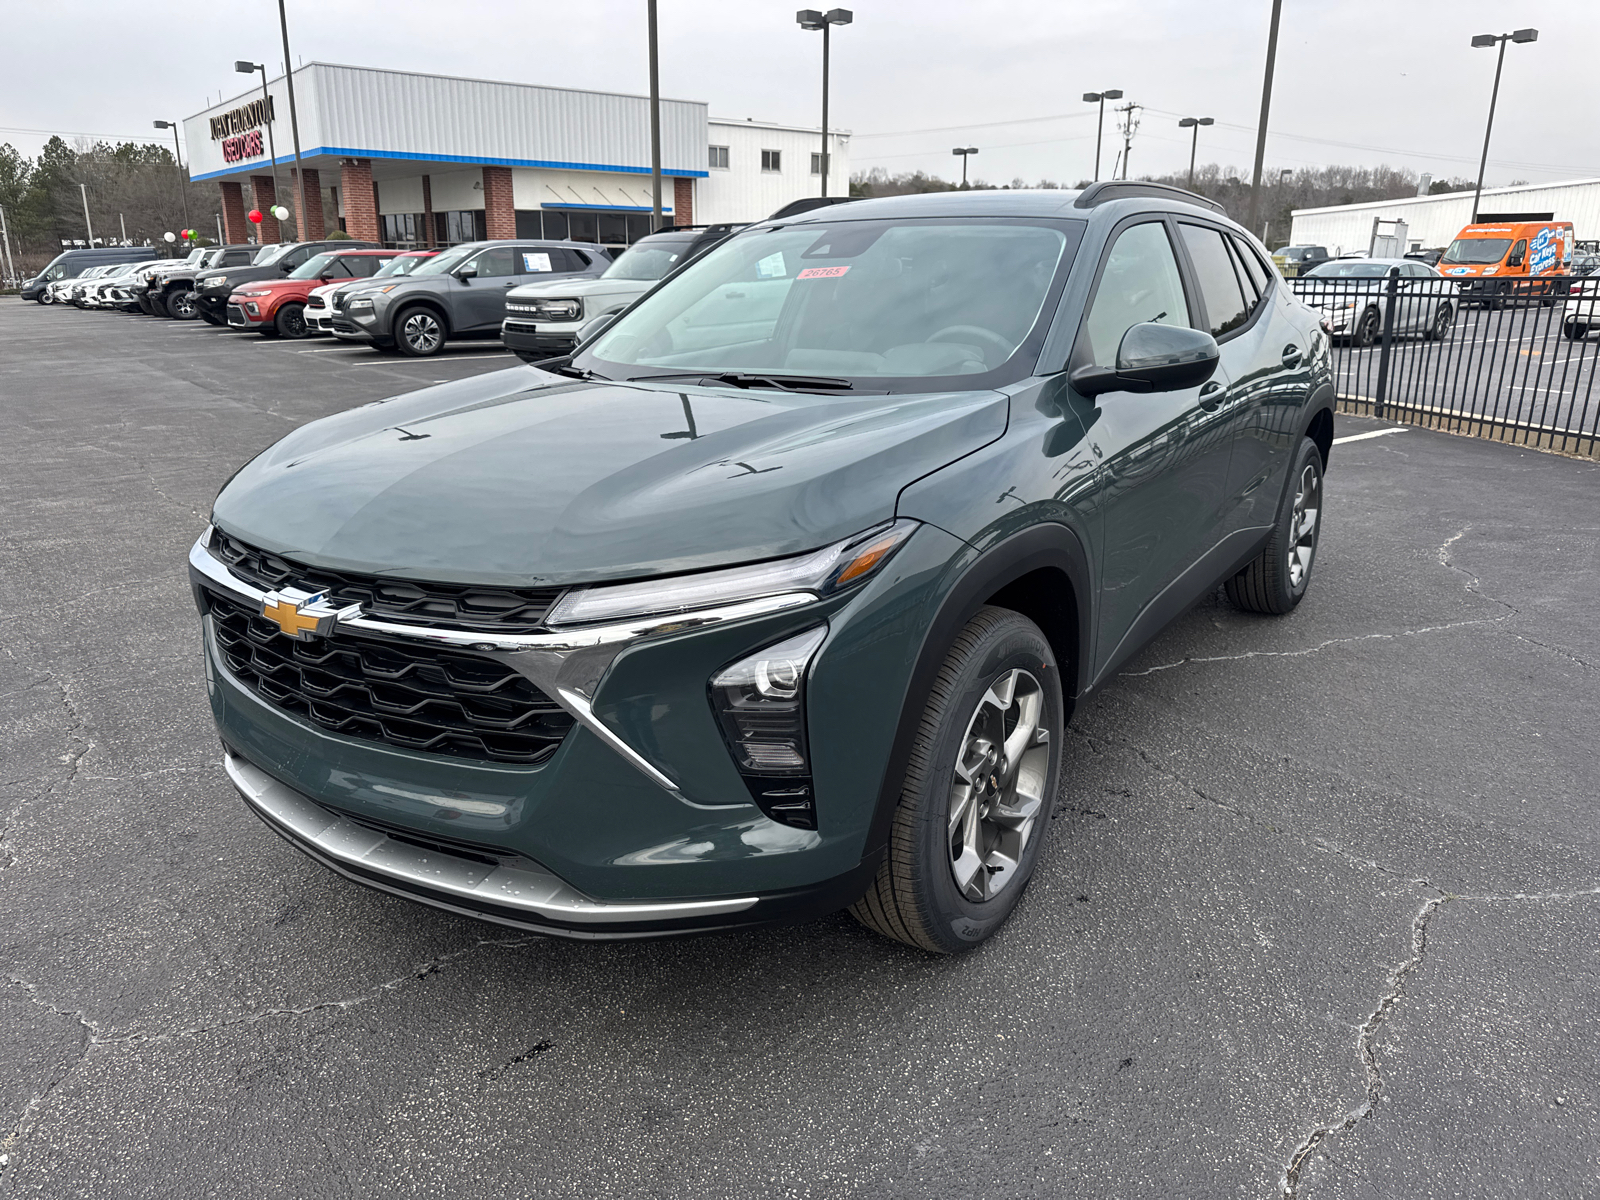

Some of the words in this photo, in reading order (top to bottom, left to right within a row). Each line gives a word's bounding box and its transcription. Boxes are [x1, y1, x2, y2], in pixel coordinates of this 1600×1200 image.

[222, 137, 240, 163] USED
[241, 130, 263, 158] CARS
[1530, 252, 1541, 266] Car
[1541, 243, 1556, 259] Keys
[804, 267, 842, 277] 26765
[1530, 255, 1556, 273] Express
[962, 925, 982, 937] HP2
